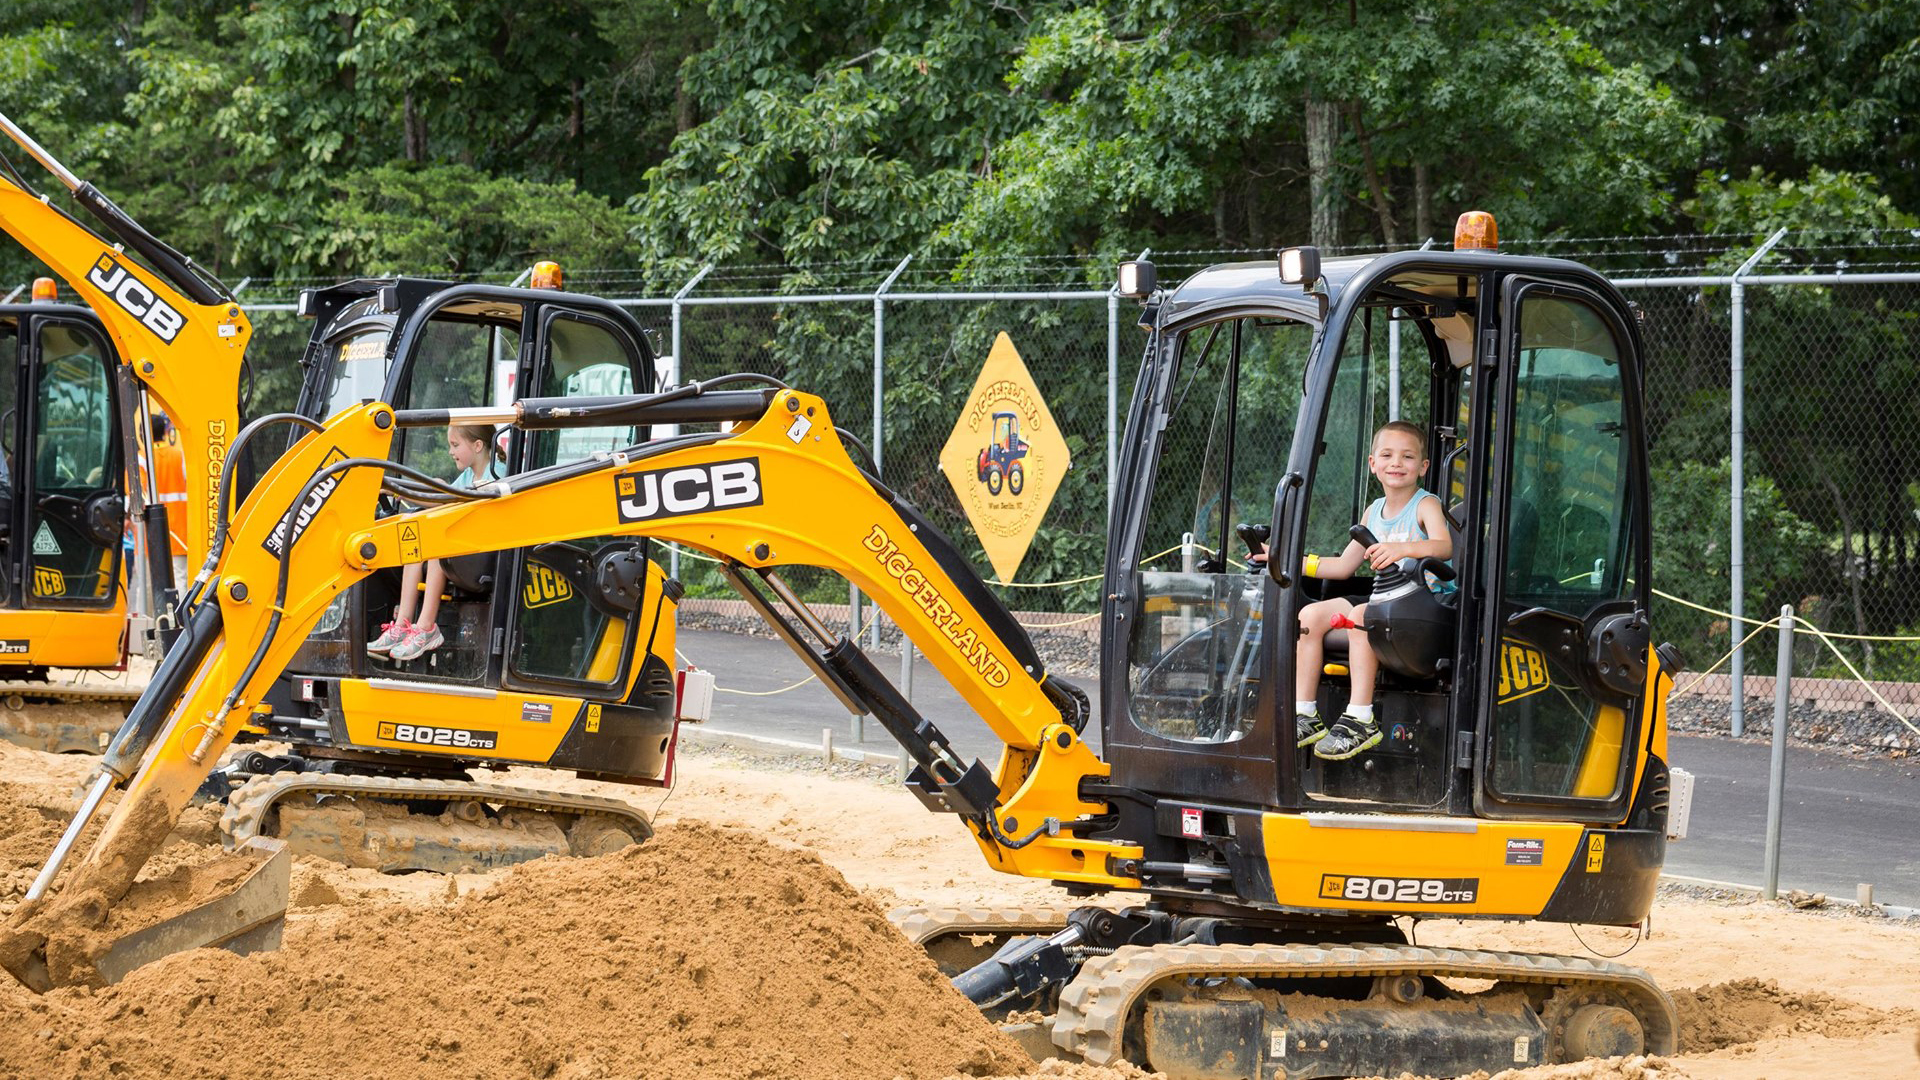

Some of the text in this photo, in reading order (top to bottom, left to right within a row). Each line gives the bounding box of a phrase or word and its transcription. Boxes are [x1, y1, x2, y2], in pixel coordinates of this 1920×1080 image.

[90, 266, 183, 341] JCB
[968, 380, 1041, 433] DIGGERLAND
[621, 462, 760, 518] JCB
[34, 570, 62, 596] JCB
[526, 563, 568, 603] JCB
[862, 524, 1010, 688] DIGGERLAND
[1499, 643, 1544, 696] JCB
